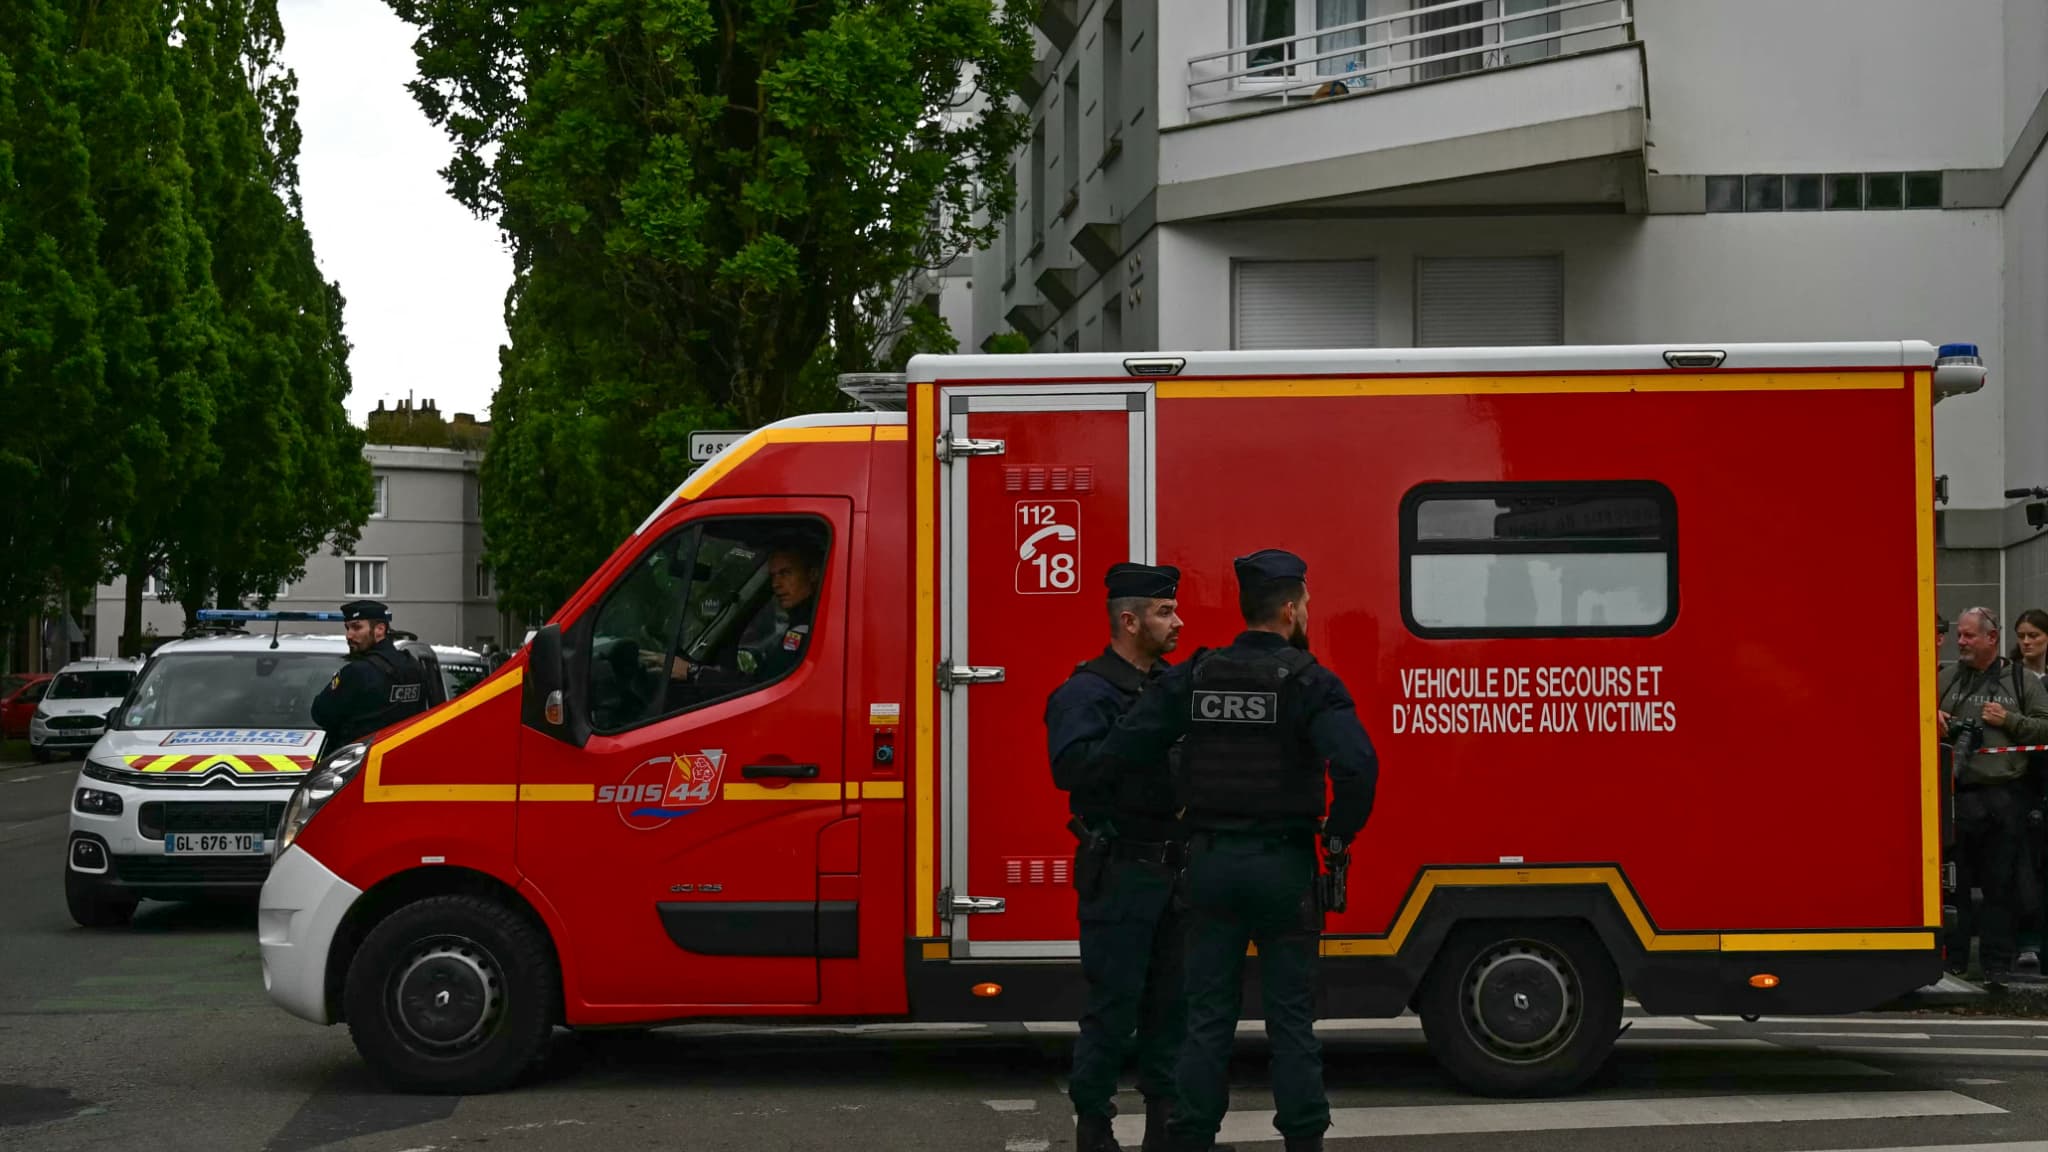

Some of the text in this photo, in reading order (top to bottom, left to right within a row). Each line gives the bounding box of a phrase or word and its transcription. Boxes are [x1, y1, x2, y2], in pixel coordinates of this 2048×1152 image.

[697, 442, 732, 455] res
[1018, 505, 1056, 525] 112
[1031, 553, 1076, 589] 18
[1400, 666, 1663, 698] VEHICULE DE SECOURS ET
[394, 686, 418, 700] CRS
[1200, 694, 1266, 720] CRS
[1392, 701, 1677, 734] D'ASSISTANCE AUX VICTIMES
[169, 737, 303, 745] MUNICIPALE
[174, 730, 304, 739] POLICE
[596, 782, 710, 803] SDIS 44
